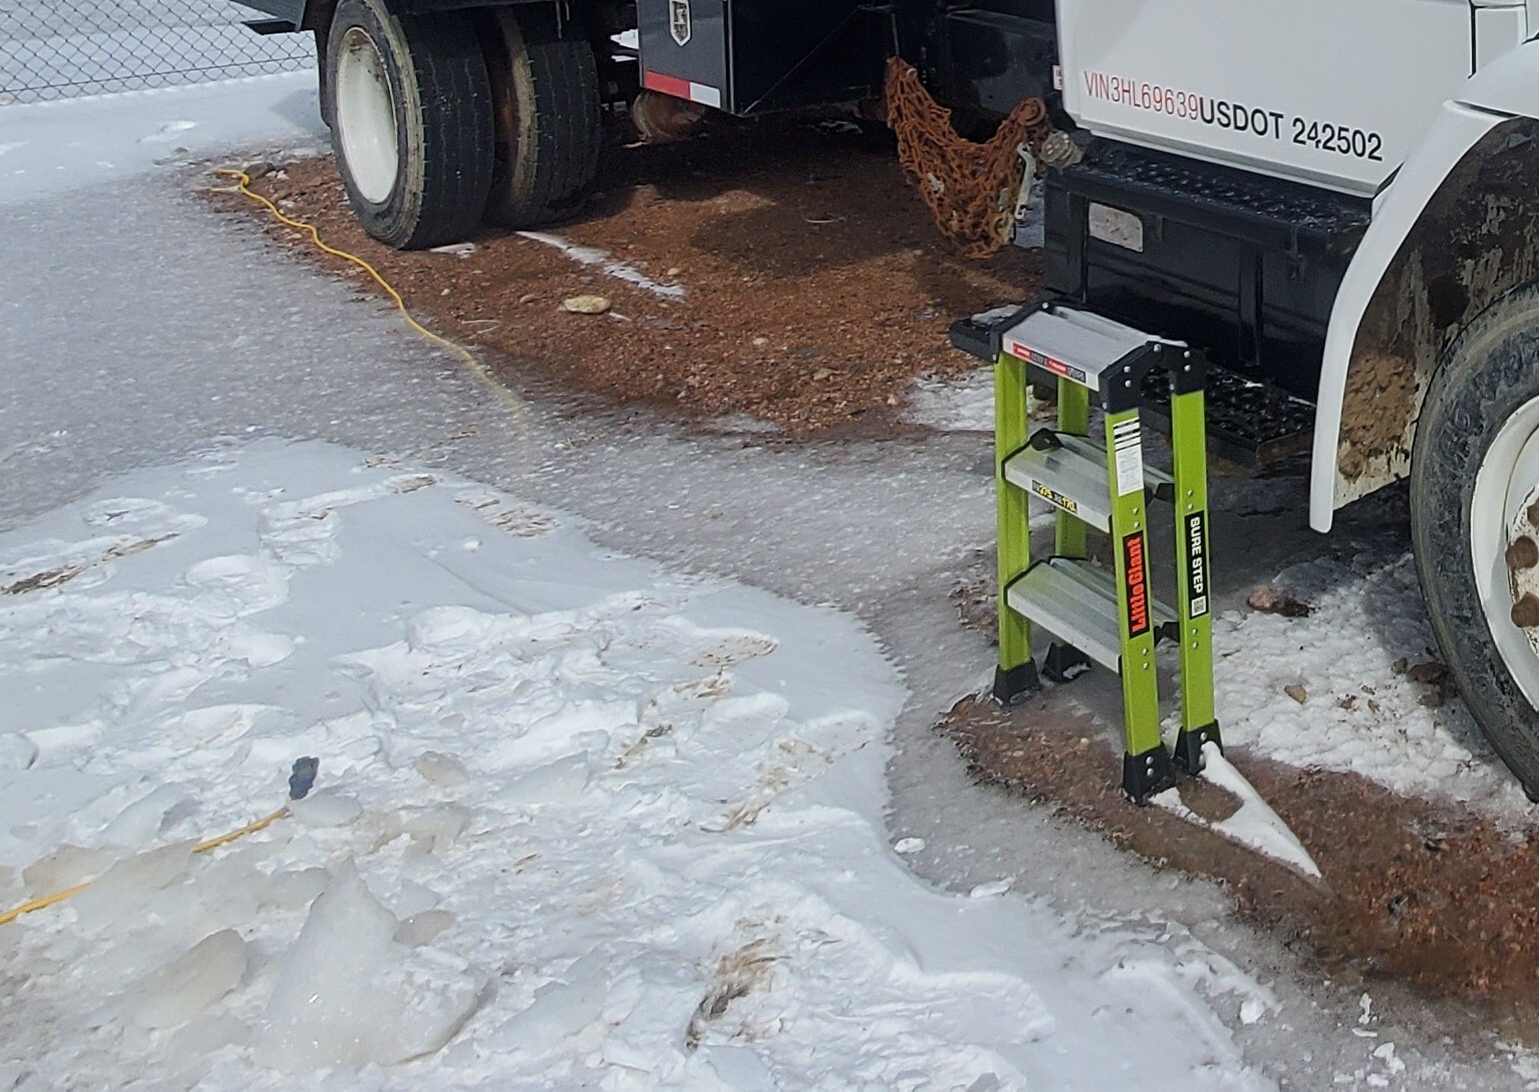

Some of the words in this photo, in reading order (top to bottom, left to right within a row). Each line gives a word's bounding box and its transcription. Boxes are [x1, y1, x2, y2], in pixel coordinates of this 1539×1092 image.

[1200, 96, 1284, 139] USDOT
[1291, 116, 1383, 161] 242502
[1190, 516, 1202, 557] SURE
[1192, 557, 1204, 594] STEP
